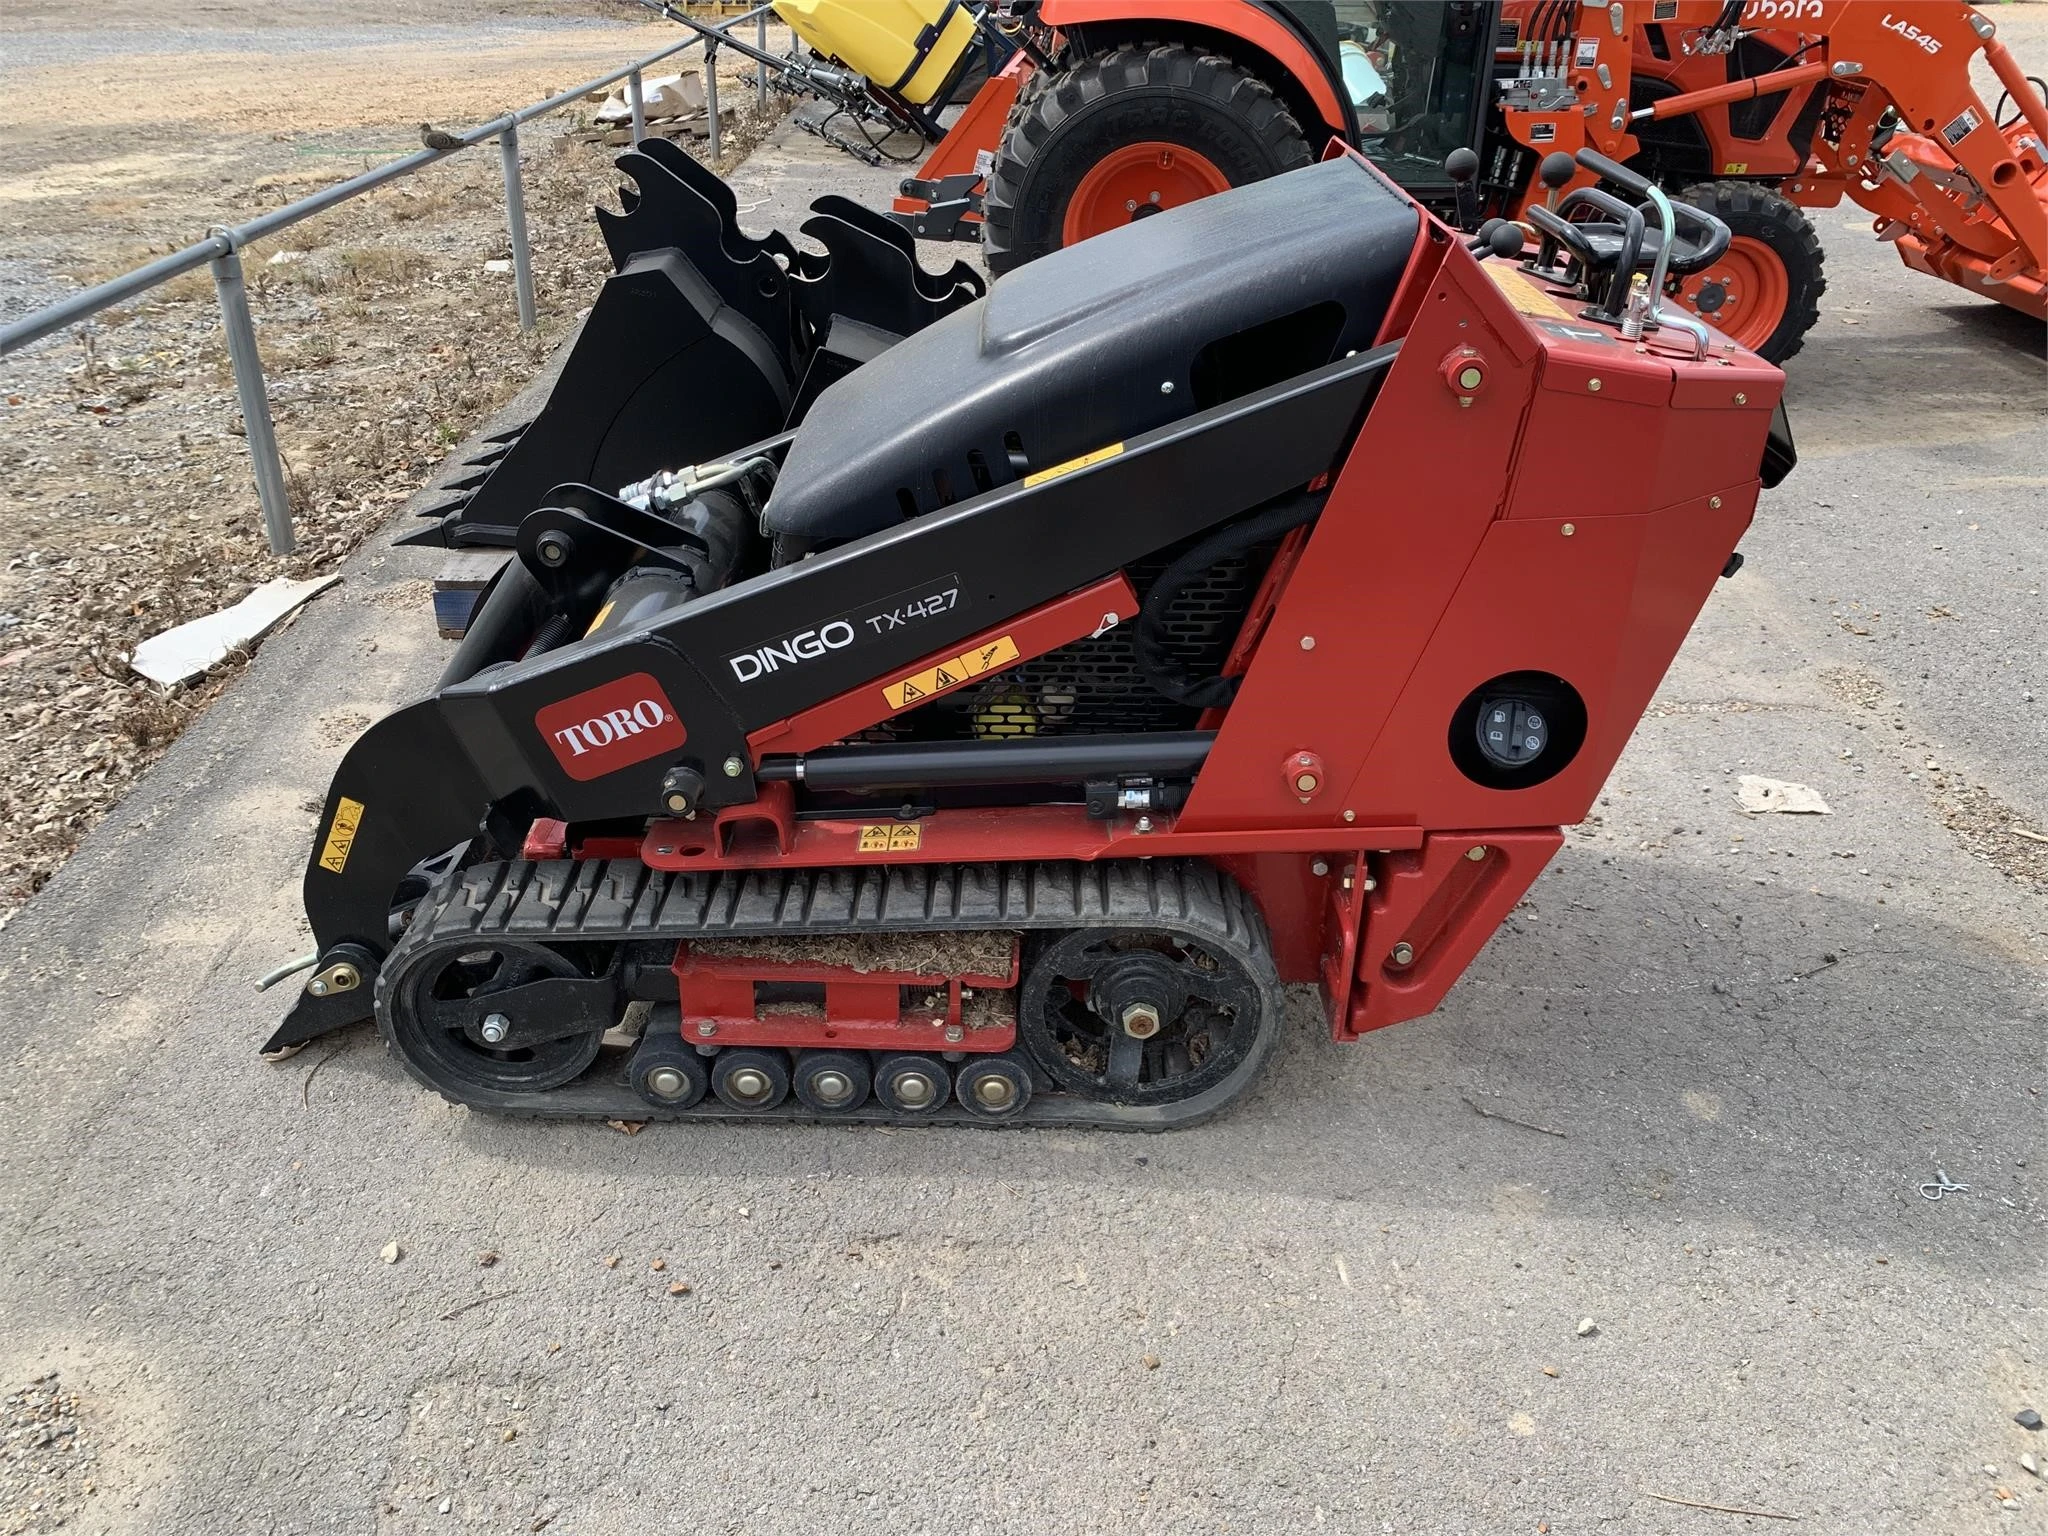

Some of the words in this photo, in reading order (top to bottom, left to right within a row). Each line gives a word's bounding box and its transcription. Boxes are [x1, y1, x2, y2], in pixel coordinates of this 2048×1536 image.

[1722, 0, 1824, 20] ubota
[1880, 13, 1943, 55] LA545
[729, 621, 855, 683] DINGO
